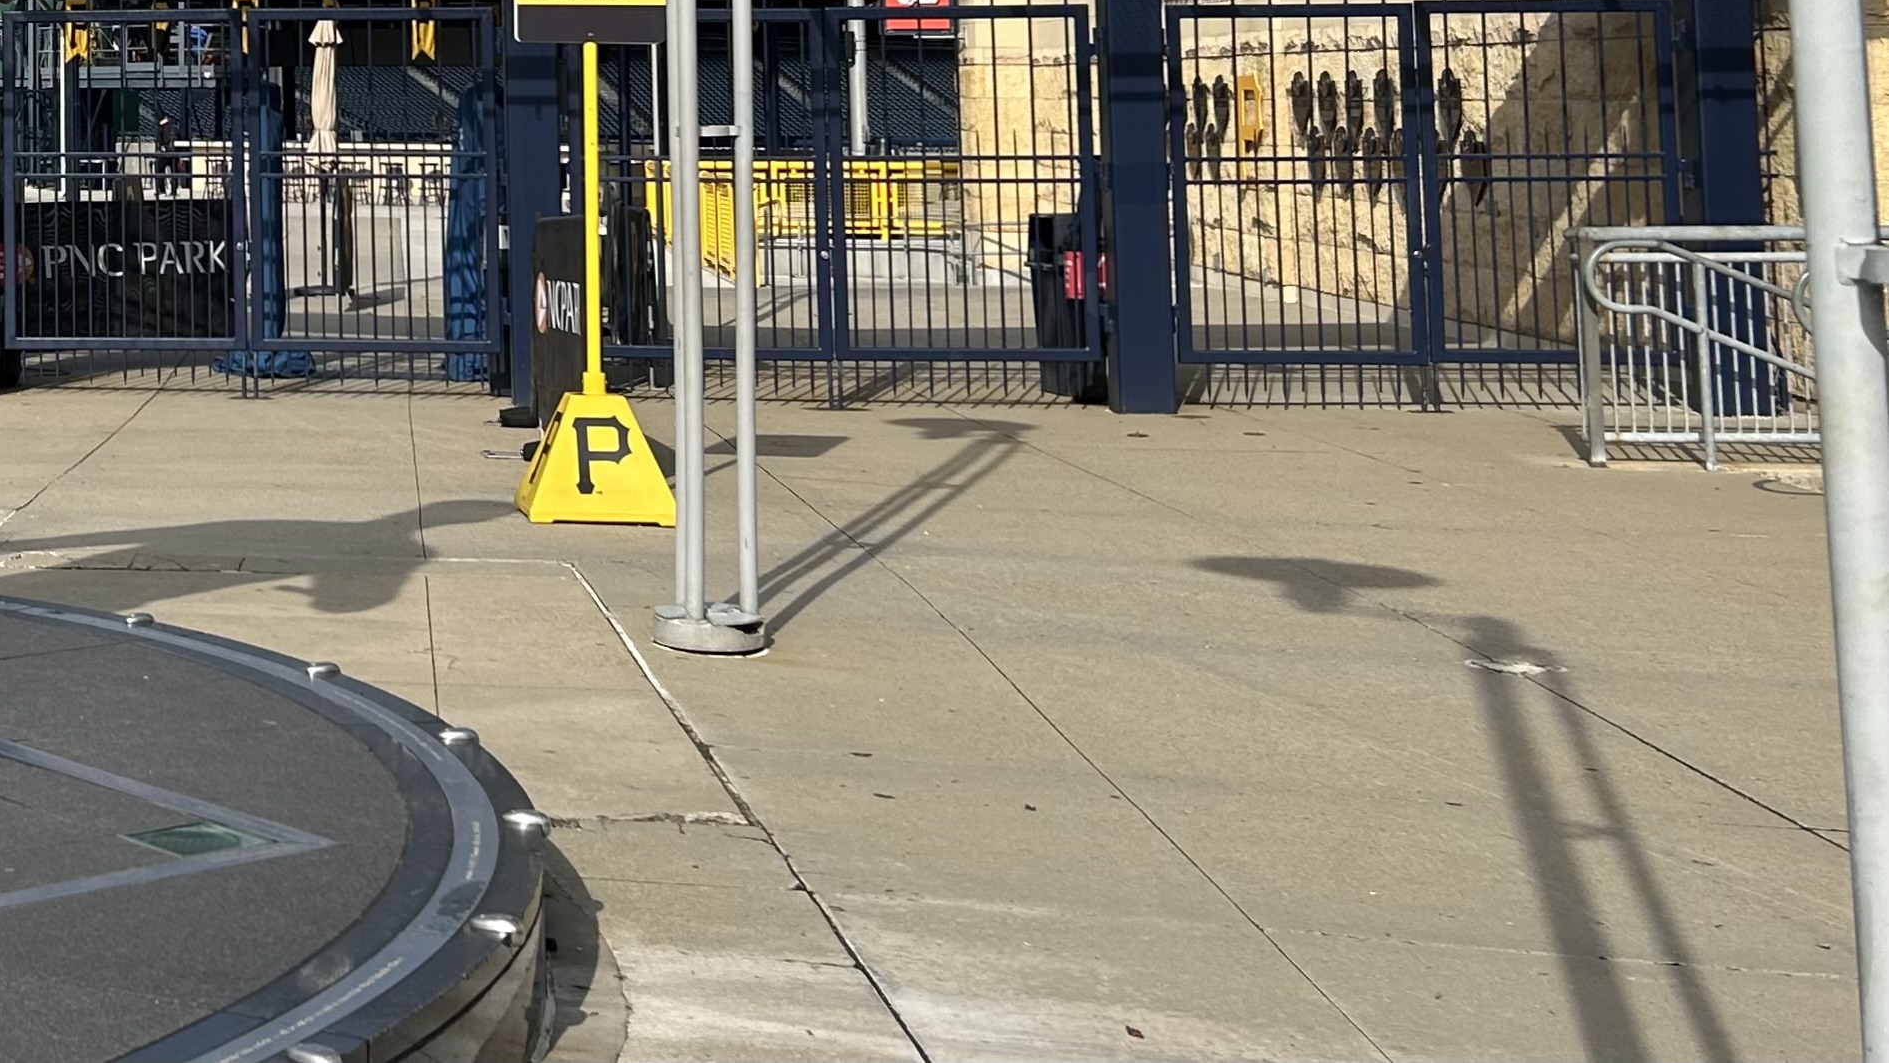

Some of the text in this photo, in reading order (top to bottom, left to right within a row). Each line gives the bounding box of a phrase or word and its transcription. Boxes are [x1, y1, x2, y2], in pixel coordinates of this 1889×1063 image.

[41, 239, 227, 279] PNC PARK
[572, 414, 633, 495] P
